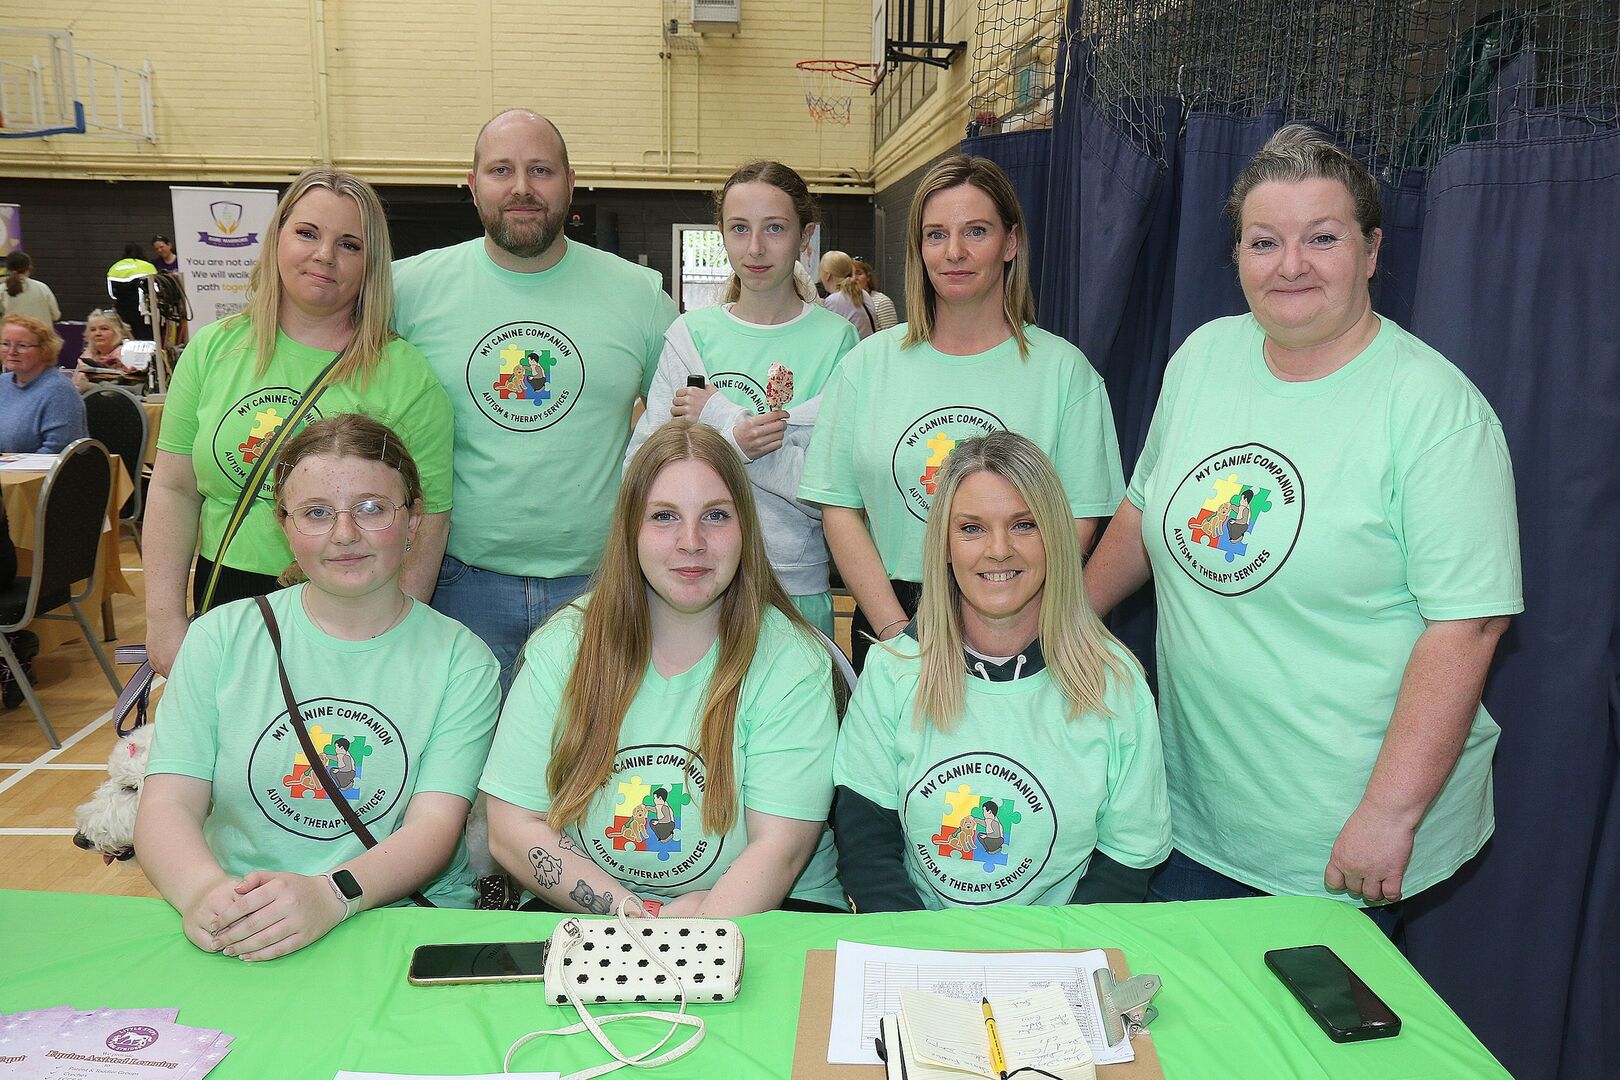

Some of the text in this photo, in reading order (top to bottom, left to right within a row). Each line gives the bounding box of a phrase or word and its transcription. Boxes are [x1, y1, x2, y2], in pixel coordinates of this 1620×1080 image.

[197, 284, 220, 292] path
[480, 328, 571, 357] MY CANINE COMPANION
[237, 403, 252, 416] MY
[252, 395, 290, 407] CANINE
[482, 391, 504, 415] AUTISM
[511, 413, 542, 423] THERAPY
[544, 390, 569, 417] SERVICES
[906, 414, 997, 447] MY CANINE COMPANI
[225, 451, 246, 479] AUTISM
[1195, 453, 1295, 505] MY CANINE COMPANION
[1174, 528, 1270, 583] AUTISM & THERAPY SERVICES
[272, 723, 289, 741] MY
[337, 708, 393, 746] COMPANION
[614, 755, 653, 774] CANINE
[920, 763, 1043, 813] MY CANINE COMPANION
[267, 788, 386, 829] AUTISM & THERAPY ERVICES
[592, 838, 618, 868] AUTISM
[628, 868, 669, 879] THERAPY
[672, 840, 708, 876] SERVICES
[916, 843, 1033, 893] AUTISM & THERAPY SERVICES
[45, 1050, 178, 1069] Equine Assisted Learning
